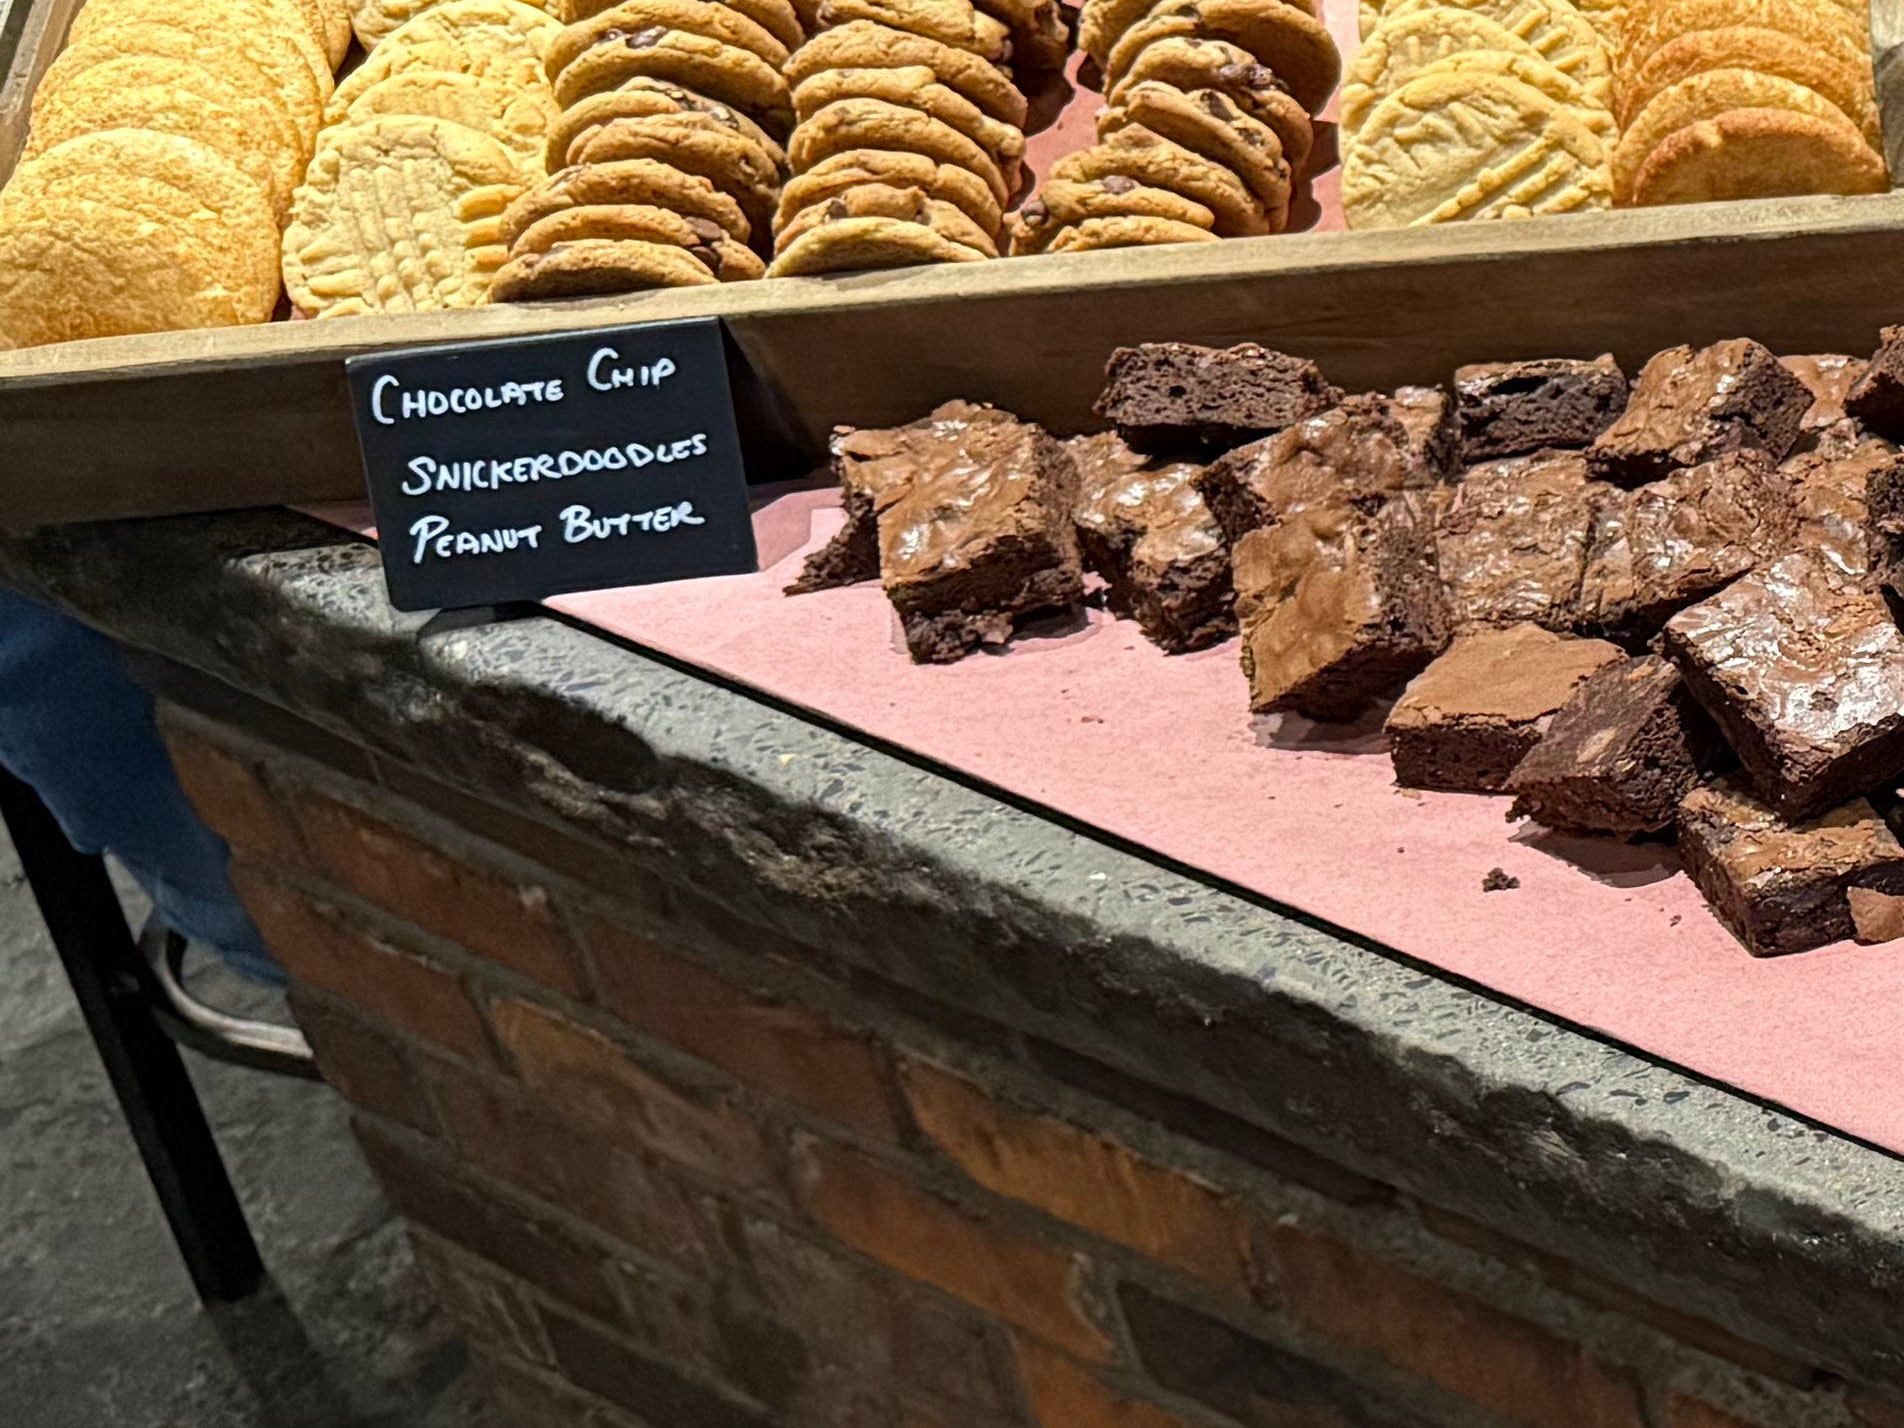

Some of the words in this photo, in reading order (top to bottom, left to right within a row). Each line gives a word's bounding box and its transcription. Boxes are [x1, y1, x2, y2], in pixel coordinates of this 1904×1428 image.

[372, 374, 565, 424] CHOCOLATE
[586, 347, 677, 391] CHIP
[402, 433, 708, 496] SNICKERDOODLES
[409, 515, 543, 564] PEANUT
[559, 501, 706, 545] BUTTER
